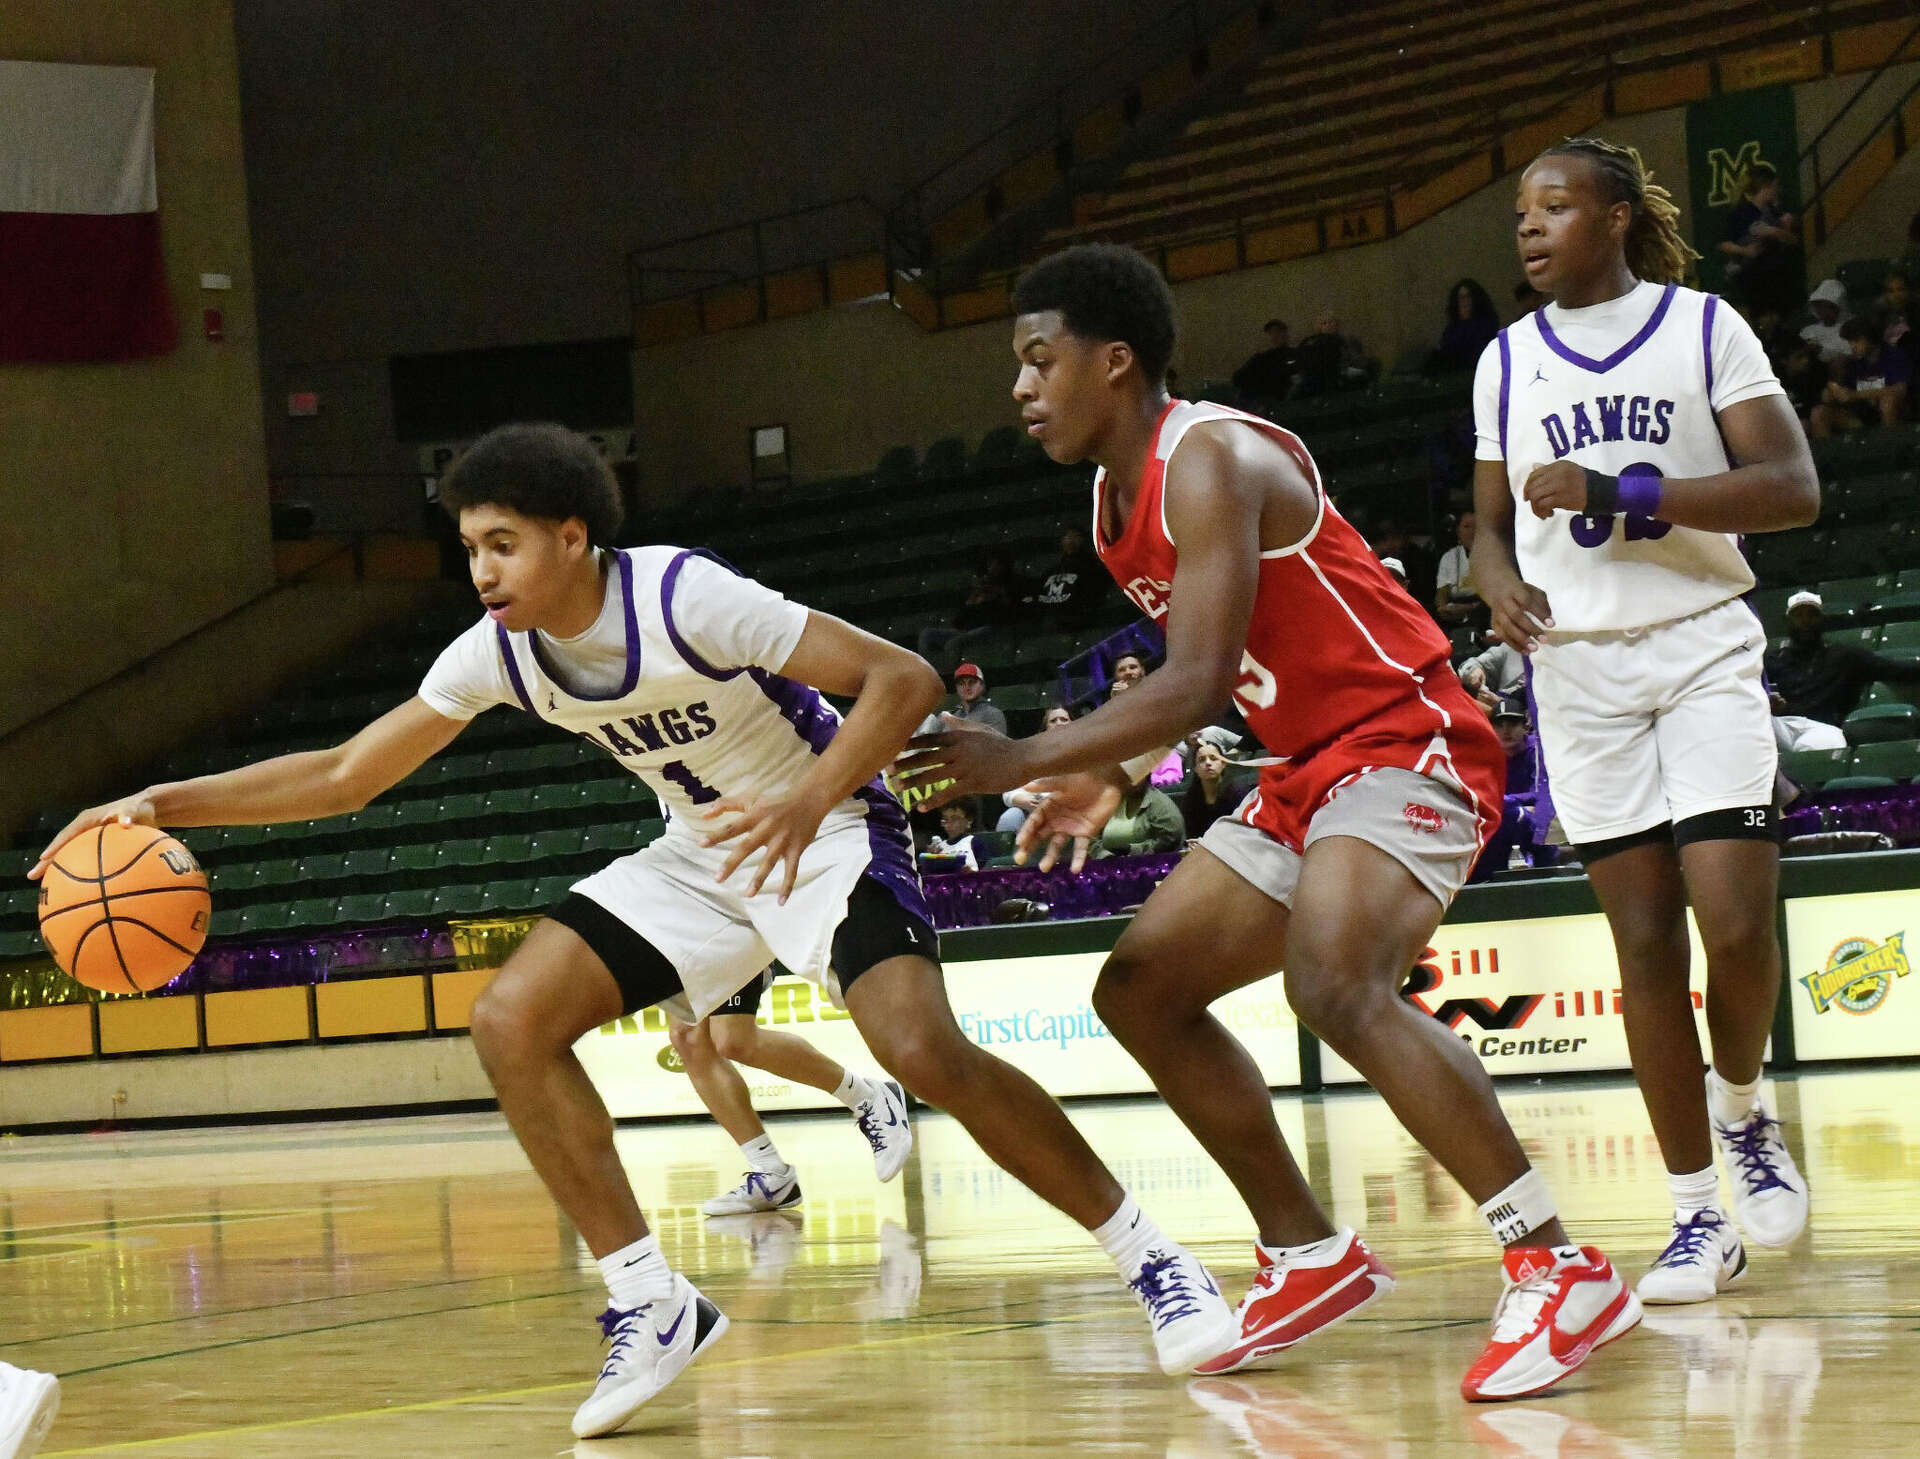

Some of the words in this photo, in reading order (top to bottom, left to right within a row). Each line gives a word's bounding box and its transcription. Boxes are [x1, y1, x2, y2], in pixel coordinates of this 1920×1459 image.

[1541, 395, 1675, 460] DAWGS
[660, 759, 722, 805] 1
[1743, 809, 1766, 827] 32
[906, 927, 919, 943] 1
[727, 995, 741, 1007] 10
[1479, 1036, 1588, 1058] Center
[1486, 1201, 1519, 1227] PHIL
